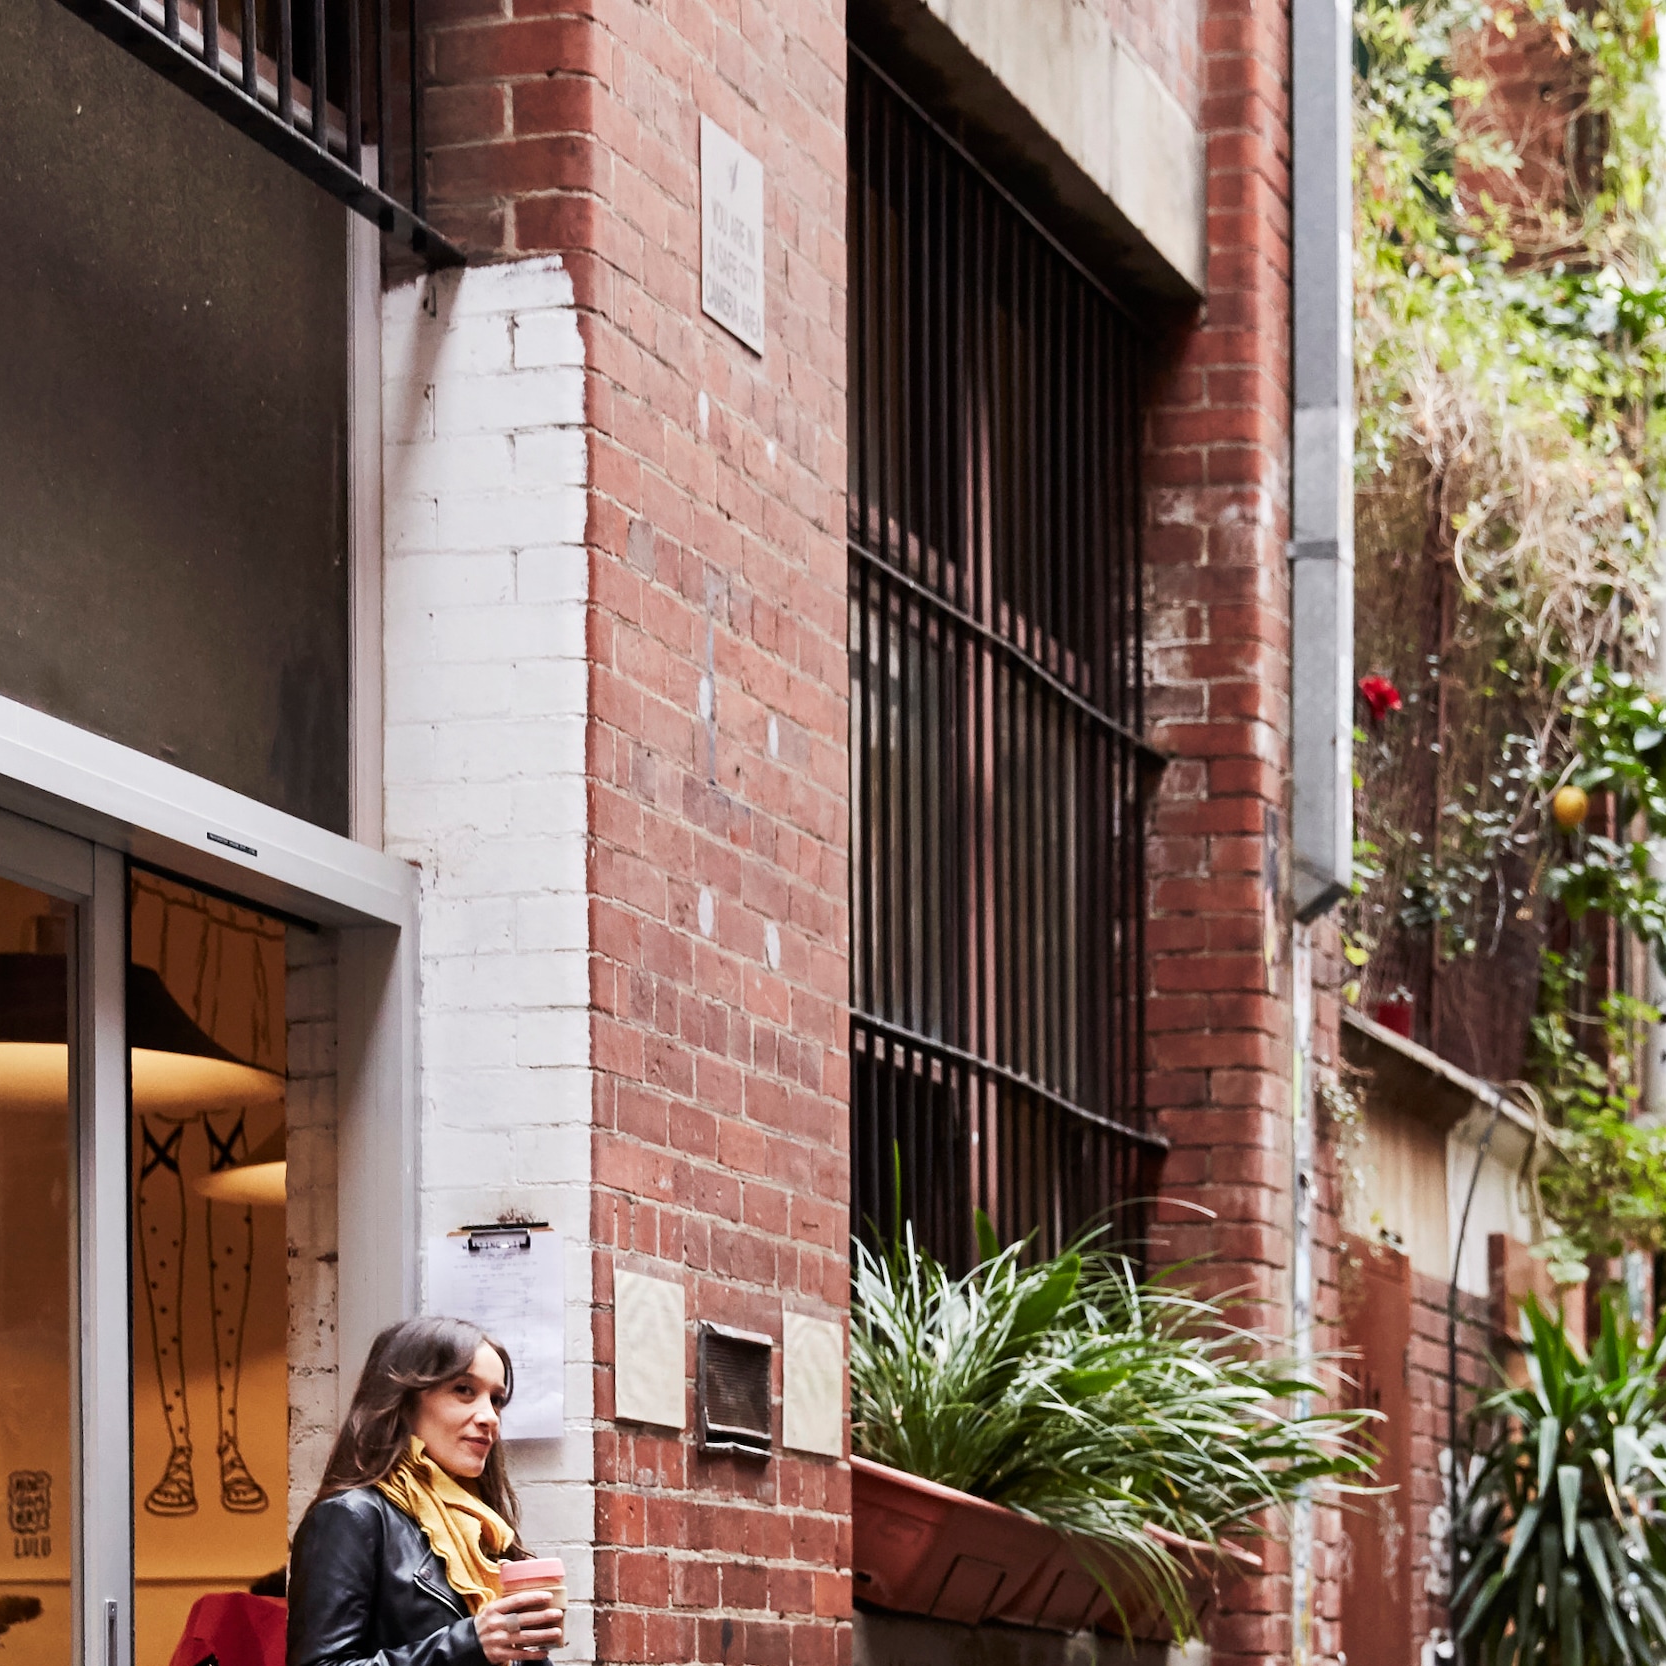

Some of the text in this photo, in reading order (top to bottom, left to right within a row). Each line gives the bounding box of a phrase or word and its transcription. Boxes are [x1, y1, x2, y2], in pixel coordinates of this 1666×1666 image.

[711, 197, 728, 236] YOU
[729, 213, 746, 252] ARE
[717, 243, 738, 286] SAFE
[739, 262, 758, 302] CITY
[705, 272, 762, 340] CAMERA AREA
